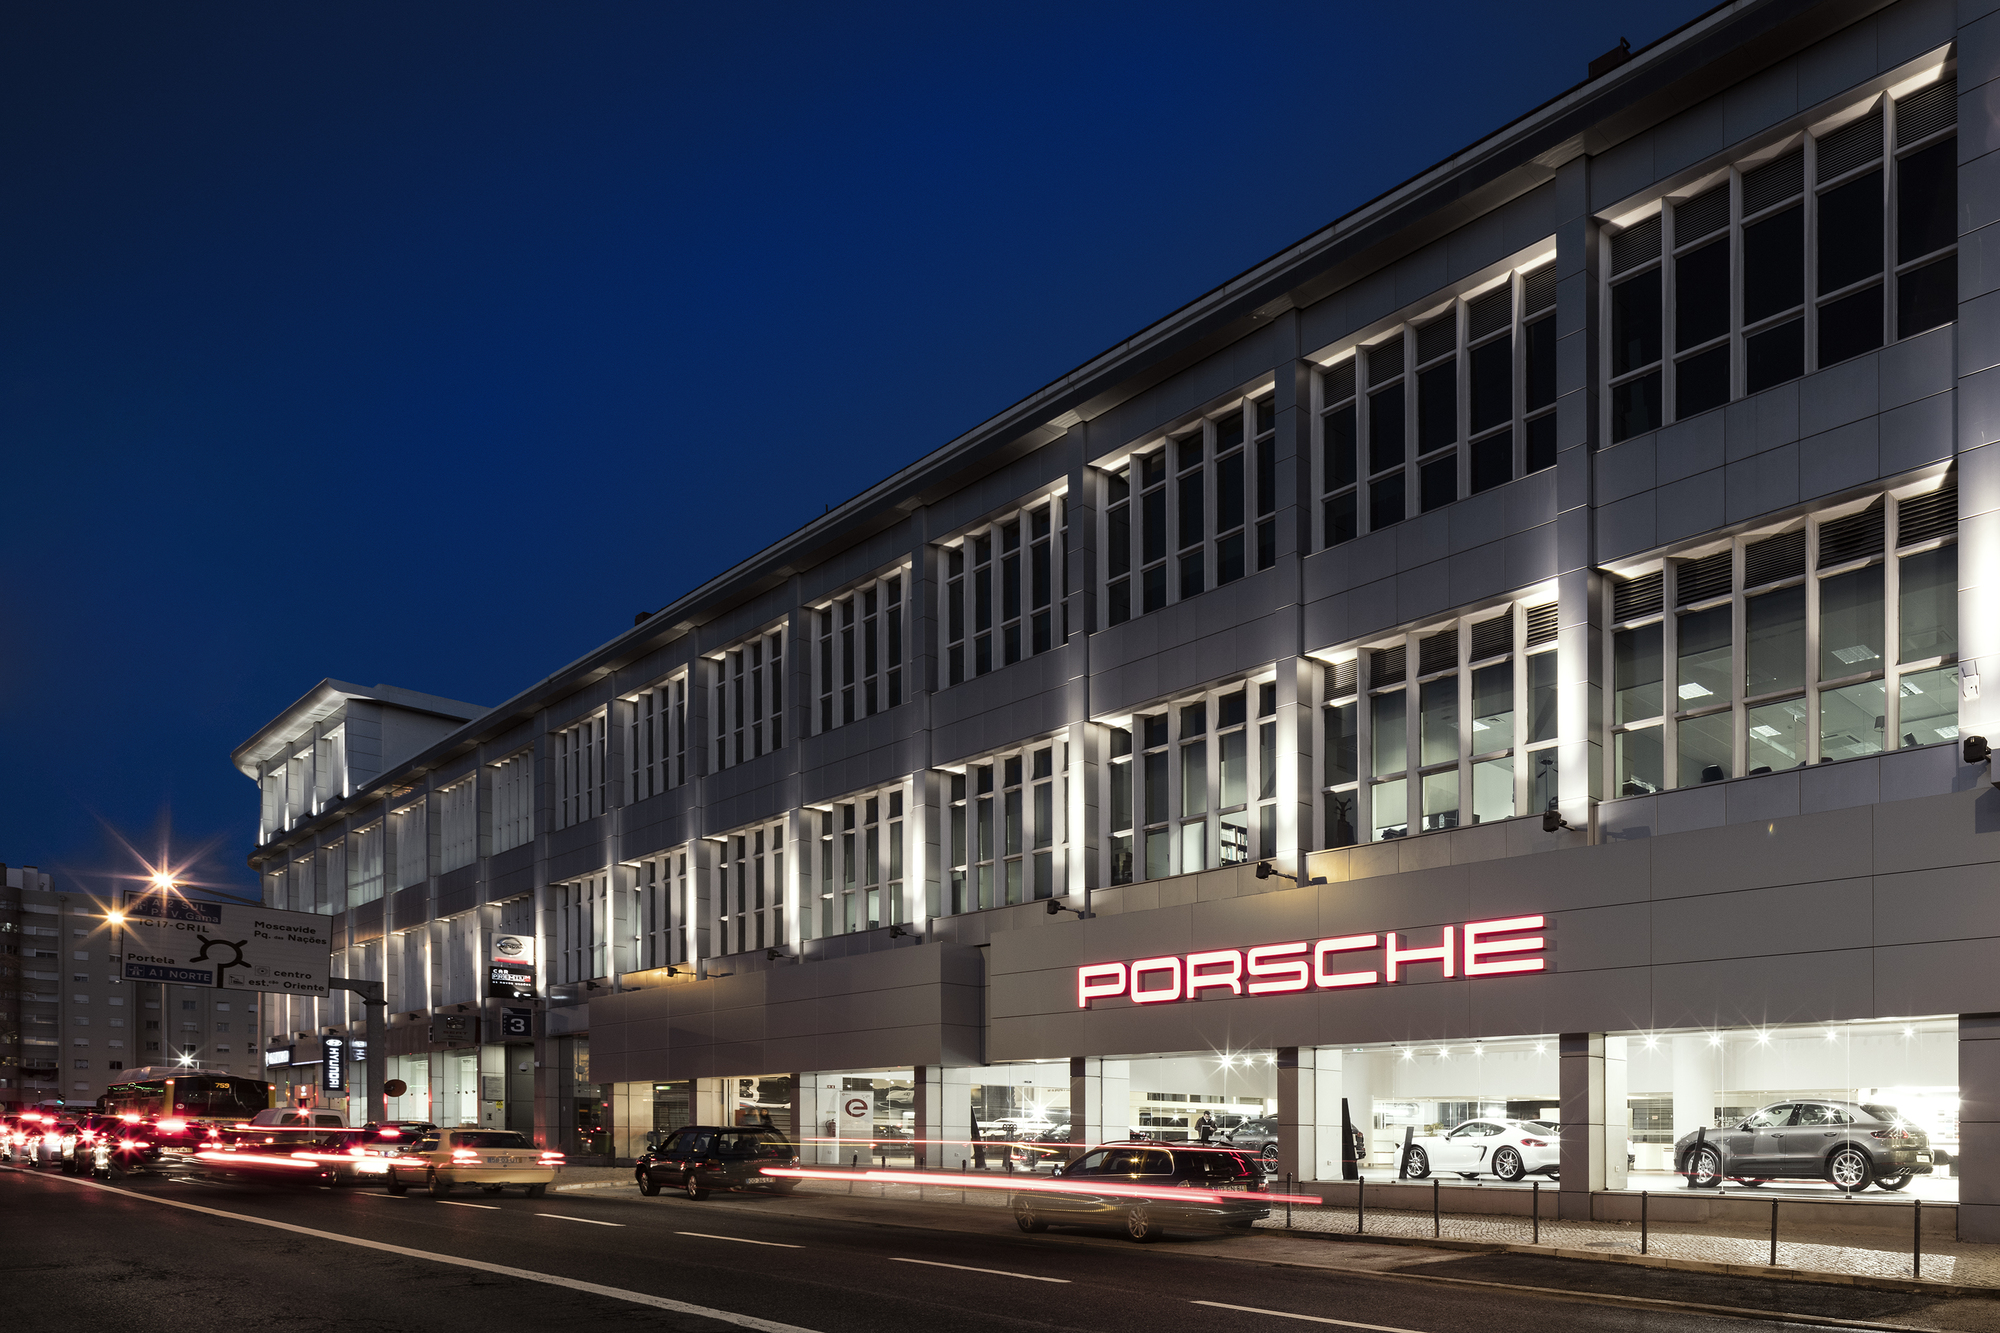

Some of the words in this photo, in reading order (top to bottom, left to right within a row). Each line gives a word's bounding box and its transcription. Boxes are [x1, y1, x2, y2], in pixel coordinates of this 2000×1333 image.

[152, 899, 174, 909] A2
[181, 901, 206, 912] SUL
[185, 912, 219, 923] Gama
[254, 921, 316, 935] Moscavide
[254, 930, 271, 940] Pq.
[288, 934, 327, 945] Nações
[128, 953, 175, 964] Portela
[1078, 915, 1545, 1008] PORSCHE
[169, 970, 211, 981] NORTE
[274, 970, 312, 980] centro
[283, 981, 325, 991] Oriente
[510, 1018, 525, 1033] 3
[328, 1047, 340, 1088] HYUNDAI
